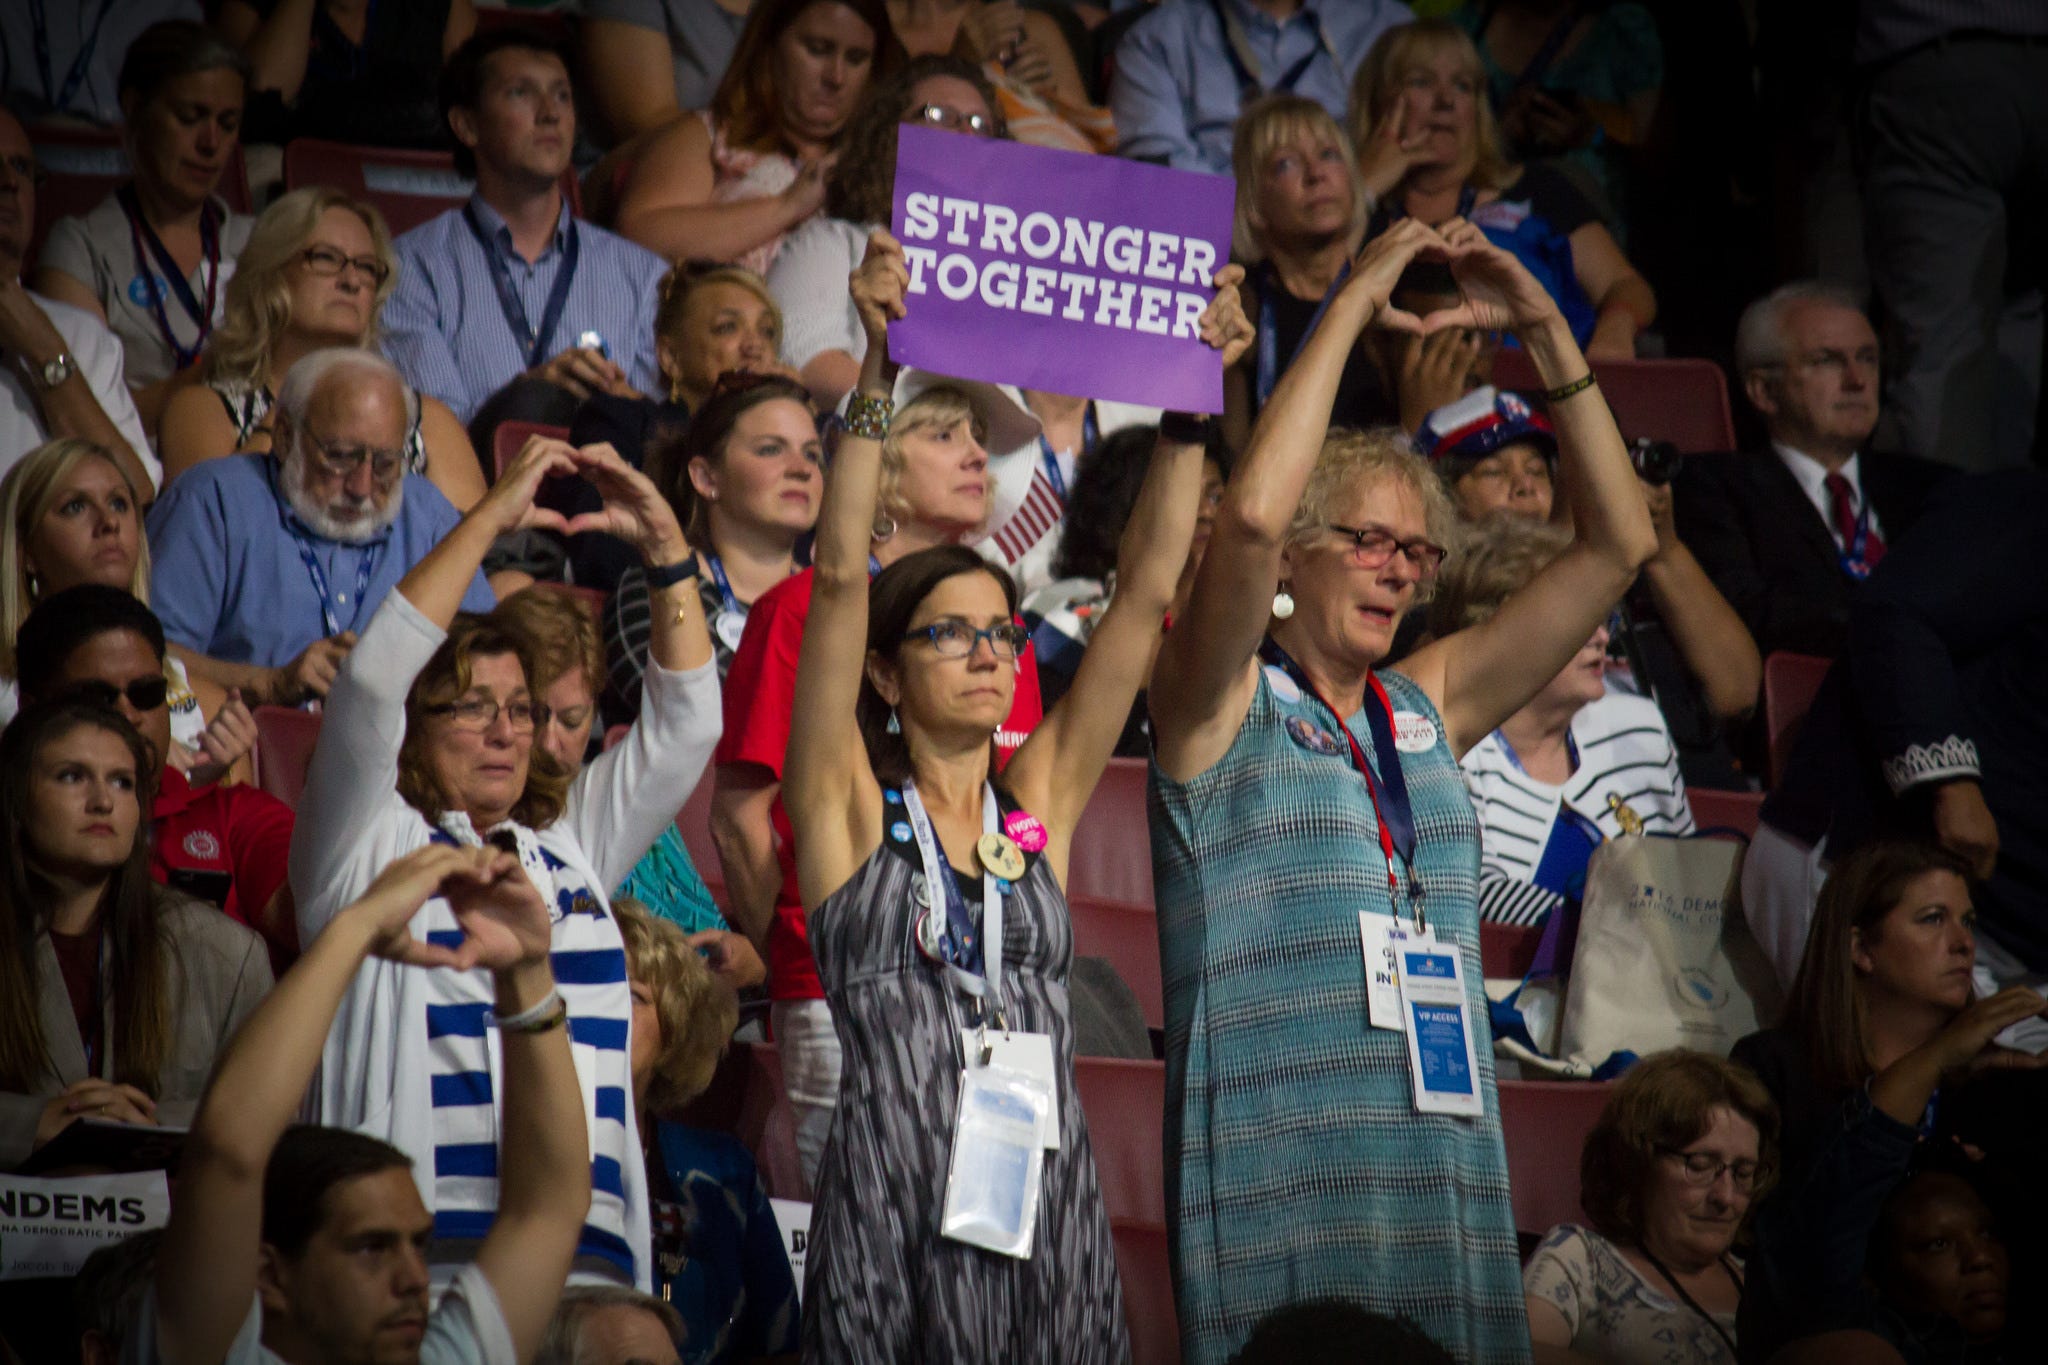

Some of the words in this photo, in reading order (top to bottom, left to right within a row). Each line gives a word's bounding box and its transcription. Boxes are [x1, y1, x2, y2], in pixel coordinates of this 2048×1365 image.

[903, 191, 1216, 288] STRONGER
[902, 245, 1209, 340] TOGETHER
[1012, 816, 1040, 834] VOTE
[1418, 1011, 1431, 1021] VIP
[1431, 1012, 1459, 1024] ACCESS
[23, 1226, 103, 1239] DEMOCRATIC
